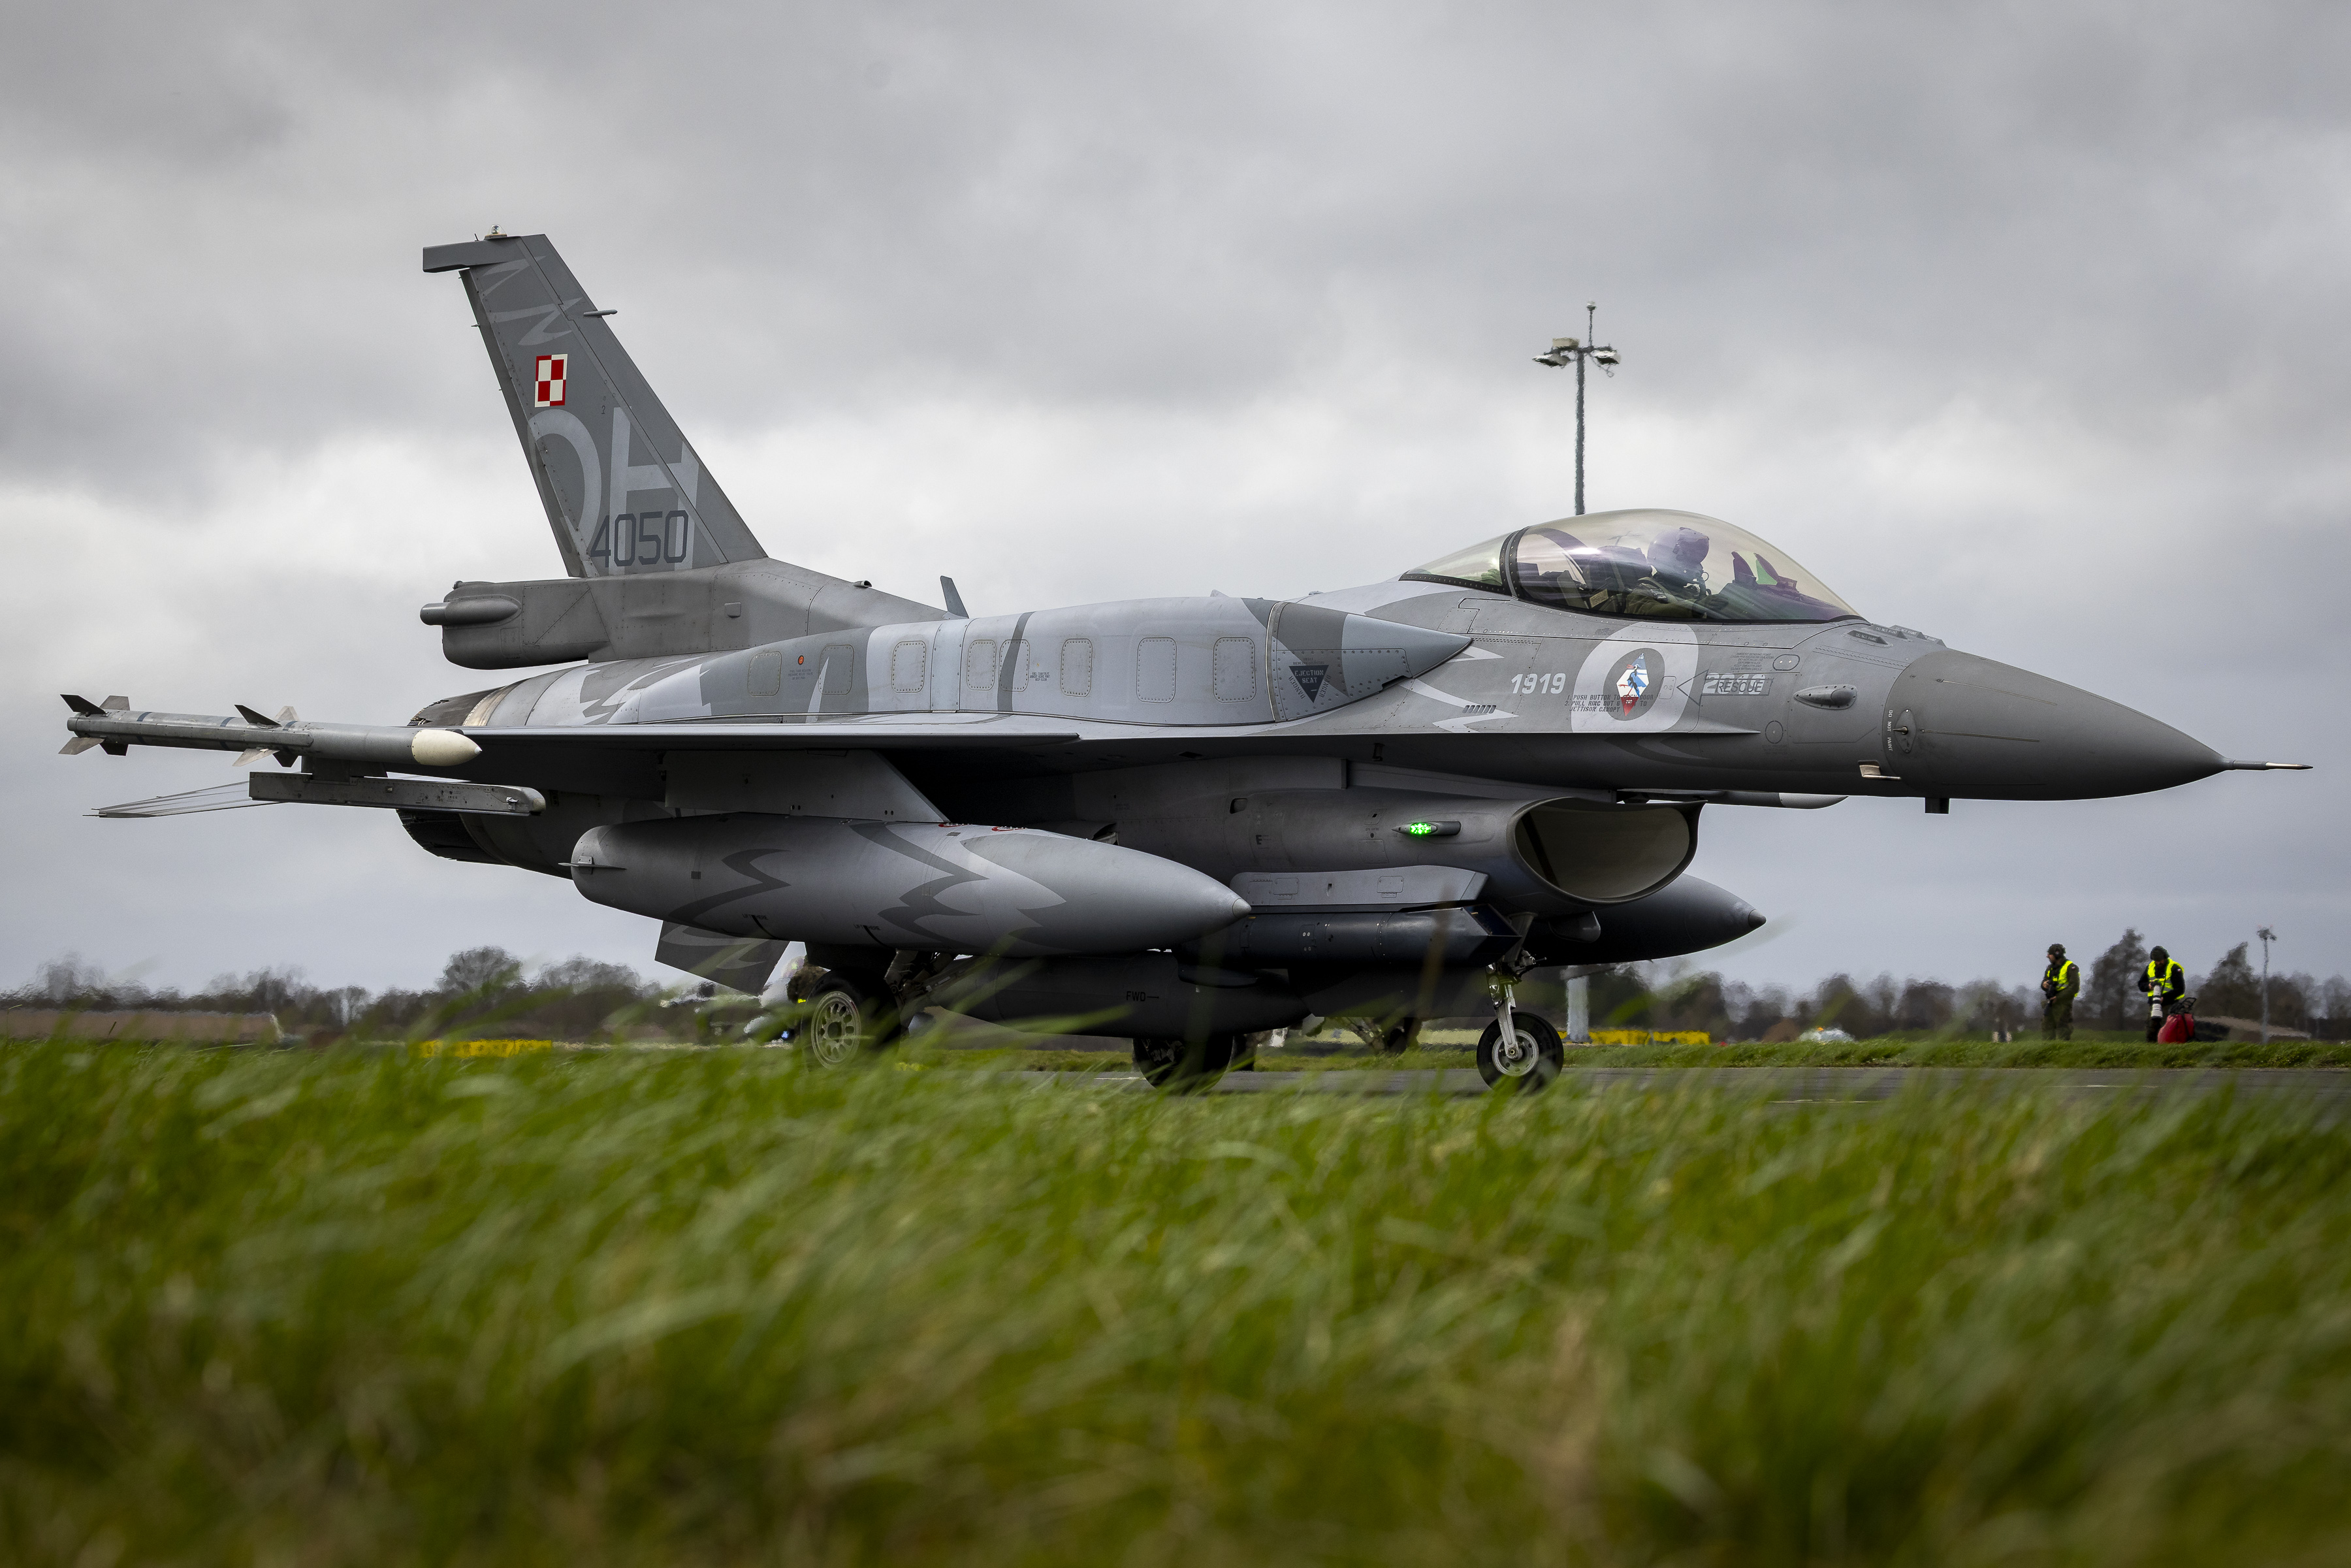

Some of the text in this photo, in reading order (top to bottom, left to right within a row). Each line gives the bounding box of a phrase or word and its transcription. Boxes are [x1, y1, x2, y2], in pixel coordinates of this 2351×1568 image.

[590, 509, 689, 568] 4050
[1288, 675, 1306, 699] DANGER
[1319, 675, 1332, 698] DANGER
[1511, 673, 1566, 694] 1919
[1715, 682, 1764, 692] RESCUE
[1126, 991, 1146, 1002] FWD
